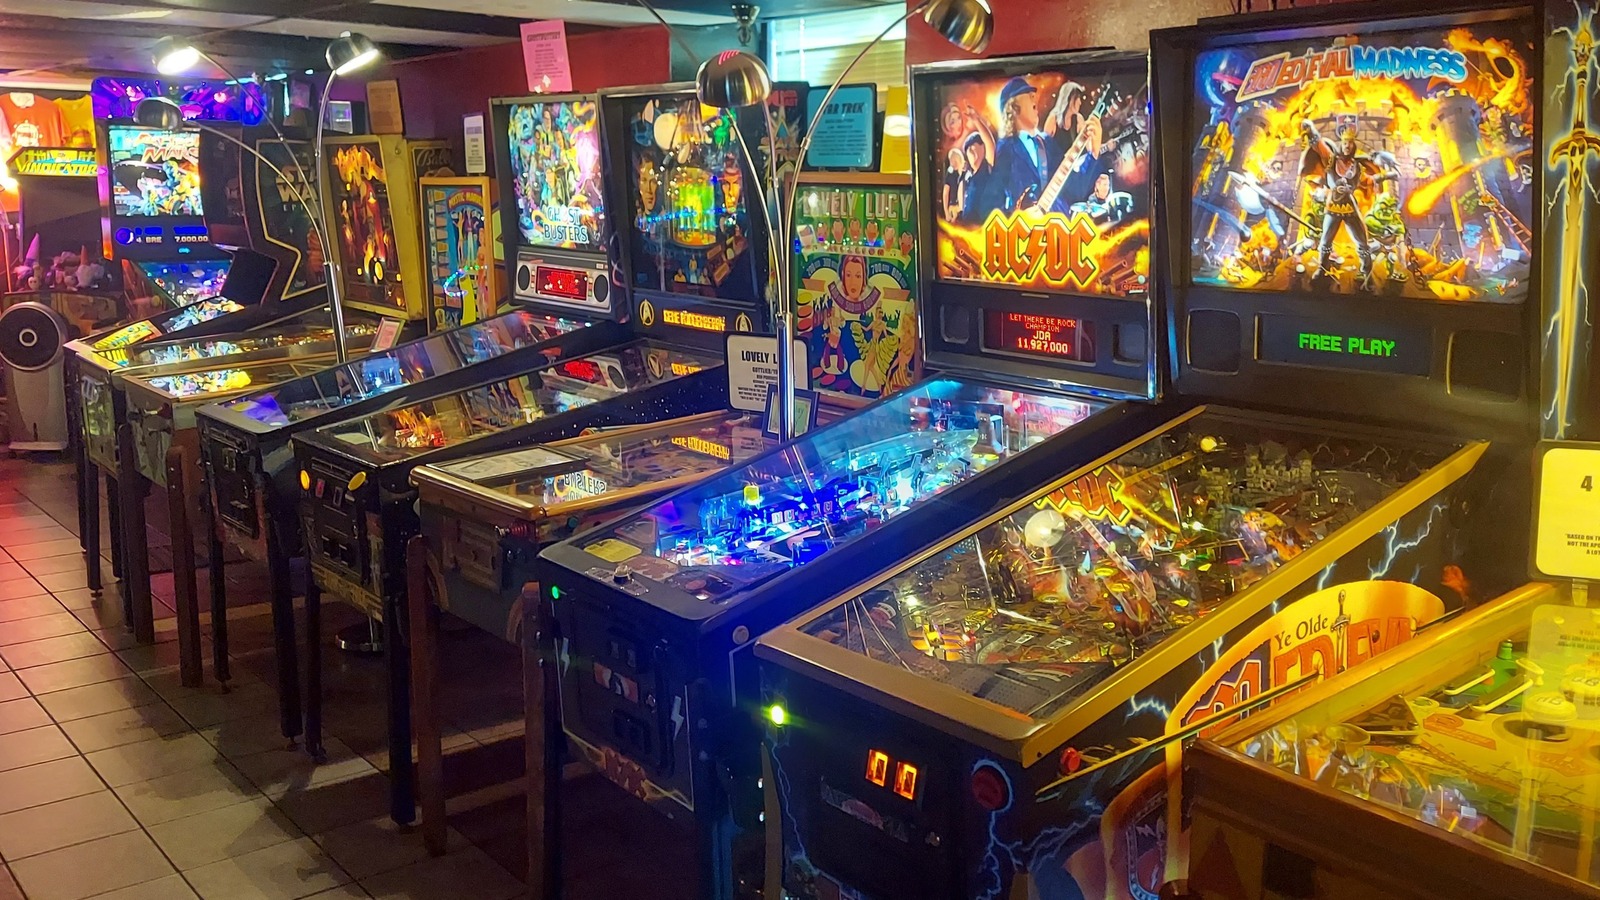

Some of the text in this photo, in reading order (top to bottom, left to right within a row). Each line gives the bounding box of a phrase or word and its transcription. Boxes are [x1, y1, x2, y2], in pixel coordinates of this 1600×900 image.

[1351, 45, 1468, 83] MADNESS
[823, 102, 864, 115] TAR TREK
[865, 192, 914, 222] LUCY
[543, 223, 588, 243] BUSTERS
[1009, 313, 1021, 321] LET
[1024, 315, 1043, 324] THERE
[1057, 319, 1076, 328] ROCK
[1025, 323, 1060, 333] CHAMPION
[1033, 331, 1051, 341] JDA
[1017, 337, 1068, 354] 11,927,000
[1298, 332, 1396, 357] FREE PLAY
[741, 350, 770, 364] LOVELY
[1580, 475, 1592, 491] 4
[1274, 614, 1328, 652] Ye Olde
